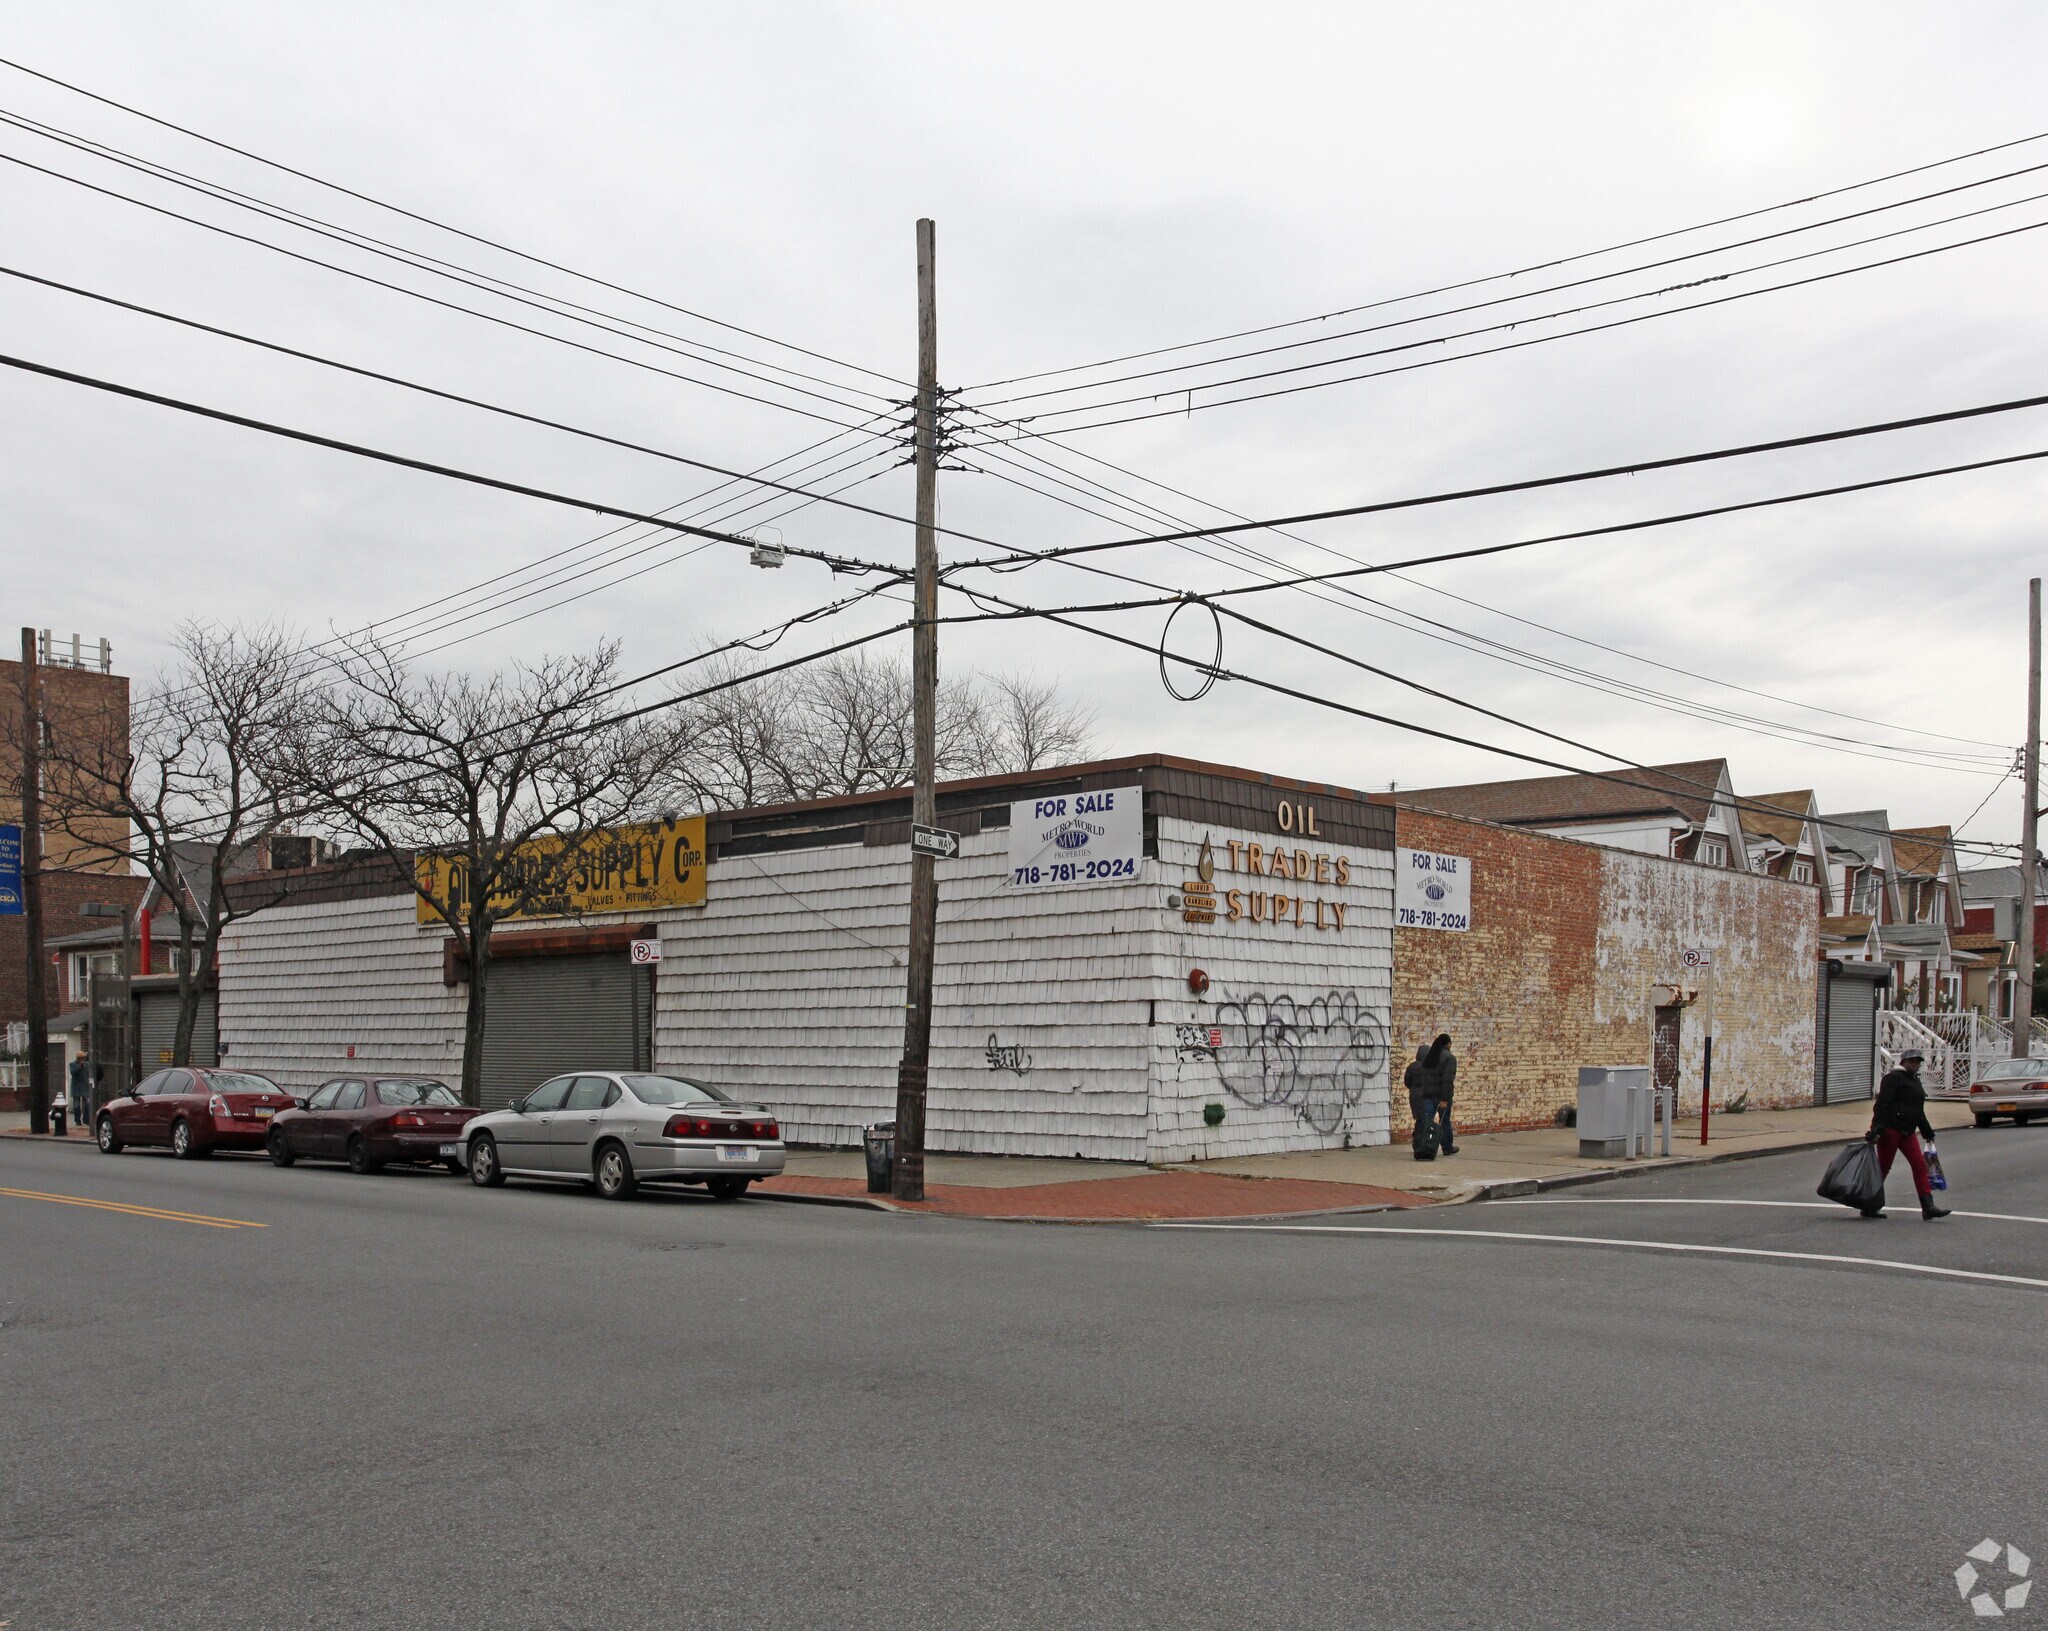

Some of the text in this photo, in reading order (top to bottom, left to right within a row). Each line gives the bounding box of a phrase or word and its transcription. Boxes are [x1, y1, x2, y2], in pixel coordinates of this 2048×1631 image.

[1035, 793, 1114, 819] FOR SALE
[1277, 800, 1320, 836] OIL
[1041, 819, 1105, 842] METRO-WORLD
[1058, 831, 1086, 848] MWP
[918, 834, 952, 850] ONE WAY
[576, 838, 665, 893] SUPPLY
[674, 836, 702, 883] CORP.
[1054, 849, 1091, 859] PROPERTIES
[1227, 839, 1350, 886] TRADES
[1412, 853, 1457, 873] FOR SALE
[1015, 858, 1135, 885] 718-781-2024
[1190, 883, 1210, 891] LIQUID
[587, 894, 614, 906] VALVES
[1399, 908, 1466, 929] 718-781-2024
